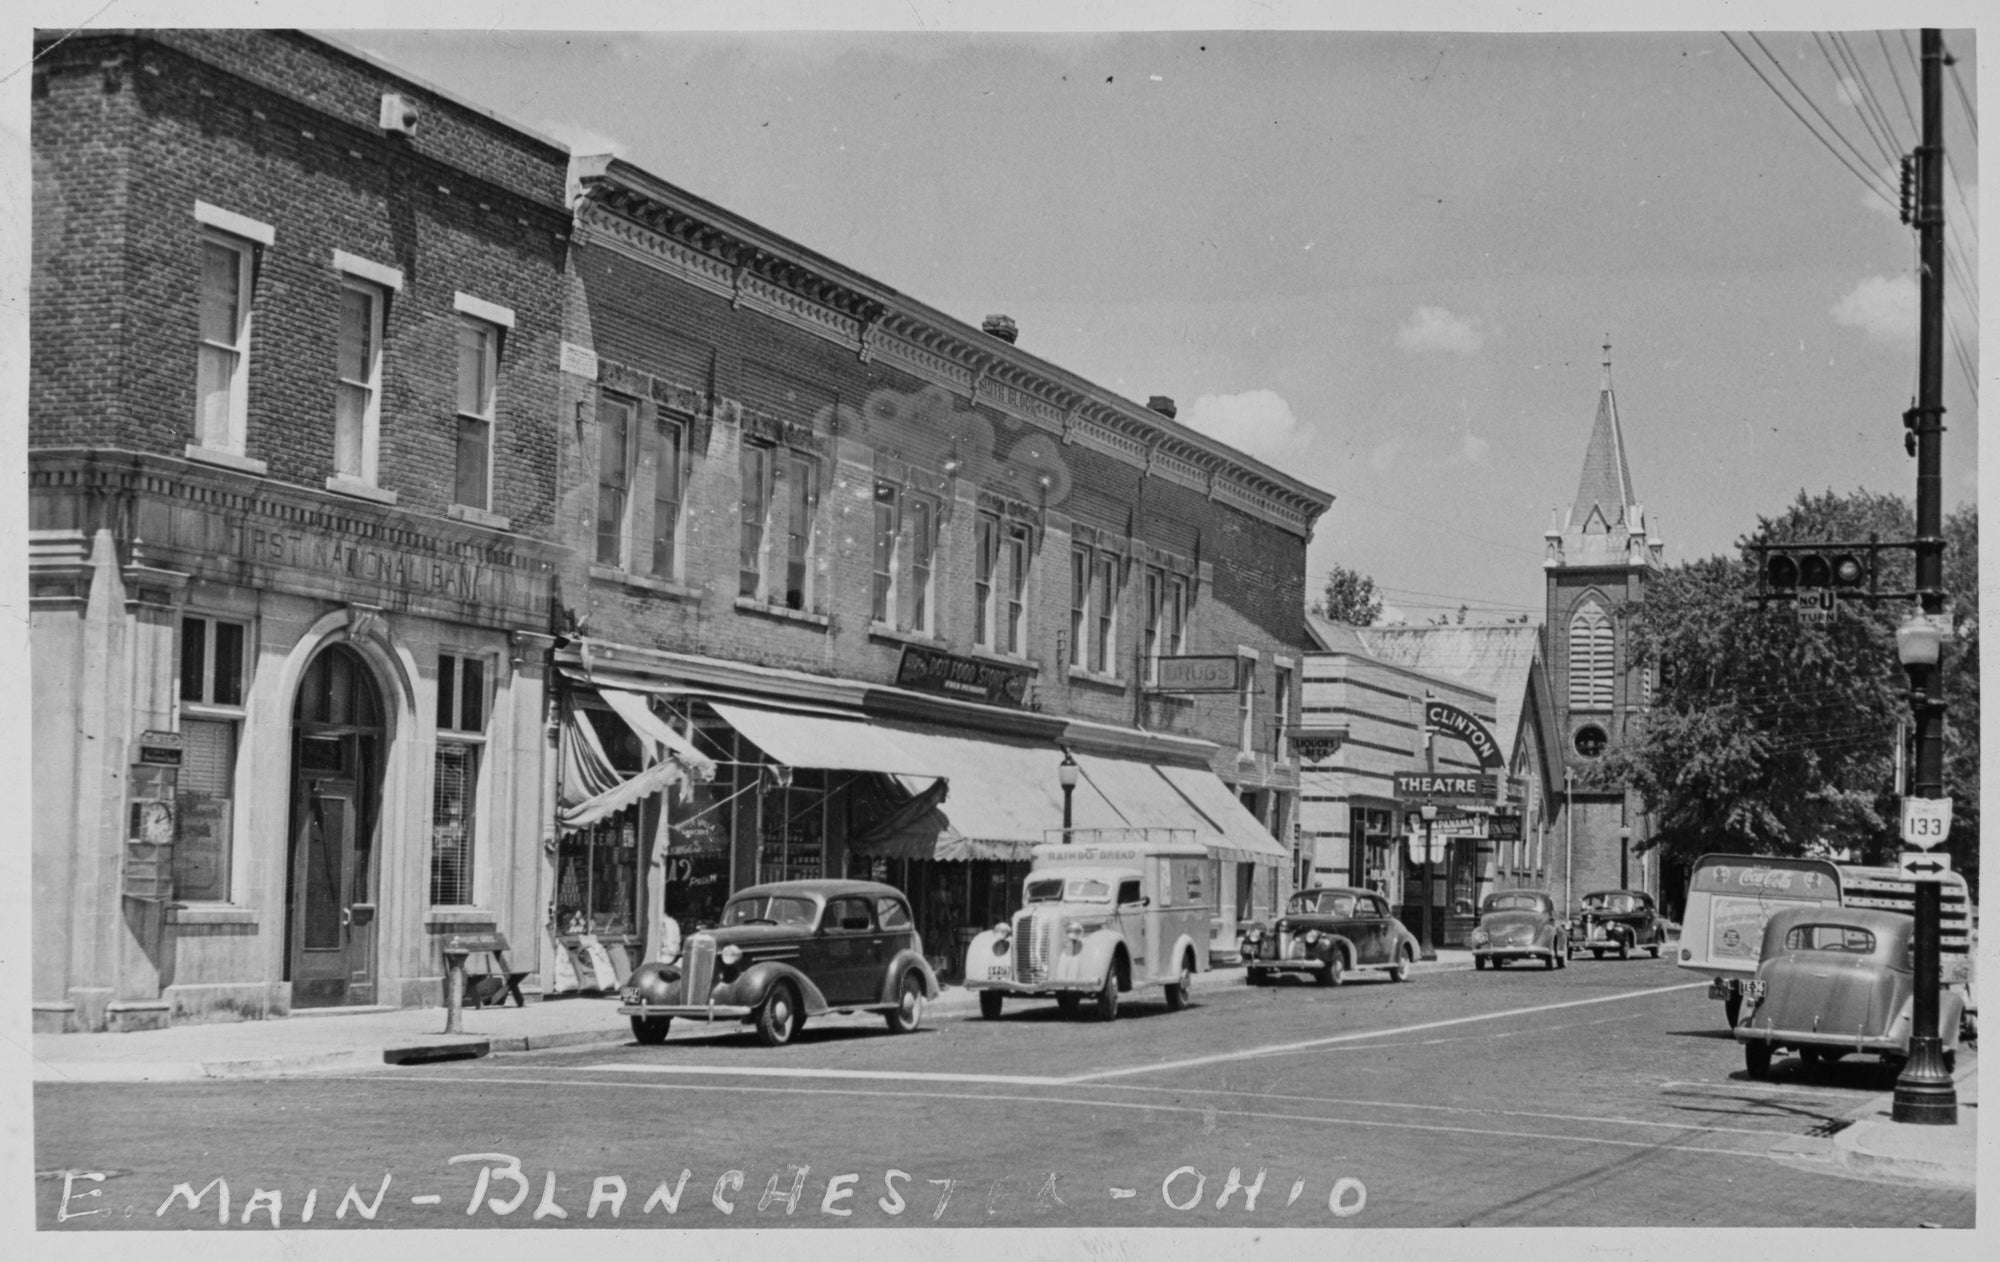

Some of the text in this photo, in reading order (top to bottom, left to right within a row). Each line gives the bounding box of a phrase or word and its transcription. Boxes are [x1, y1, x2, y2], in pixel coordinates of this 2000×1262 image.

[231, 526, 301, 566] FIRST
[313, 545, 421, 584] NATIONAL
[1800, 592, 1834, 610] NO U
[1800, 613, 1835, 622] TURN
[1166, 663, 1232, 682] DRUGS
[1429, 706, 1494, 759] CLINTON
[1399, 777, 1477, 793] THEATRE
[1911, 818, 1942, 836] 133
[1099, 850, 1136, 860] BREAD
